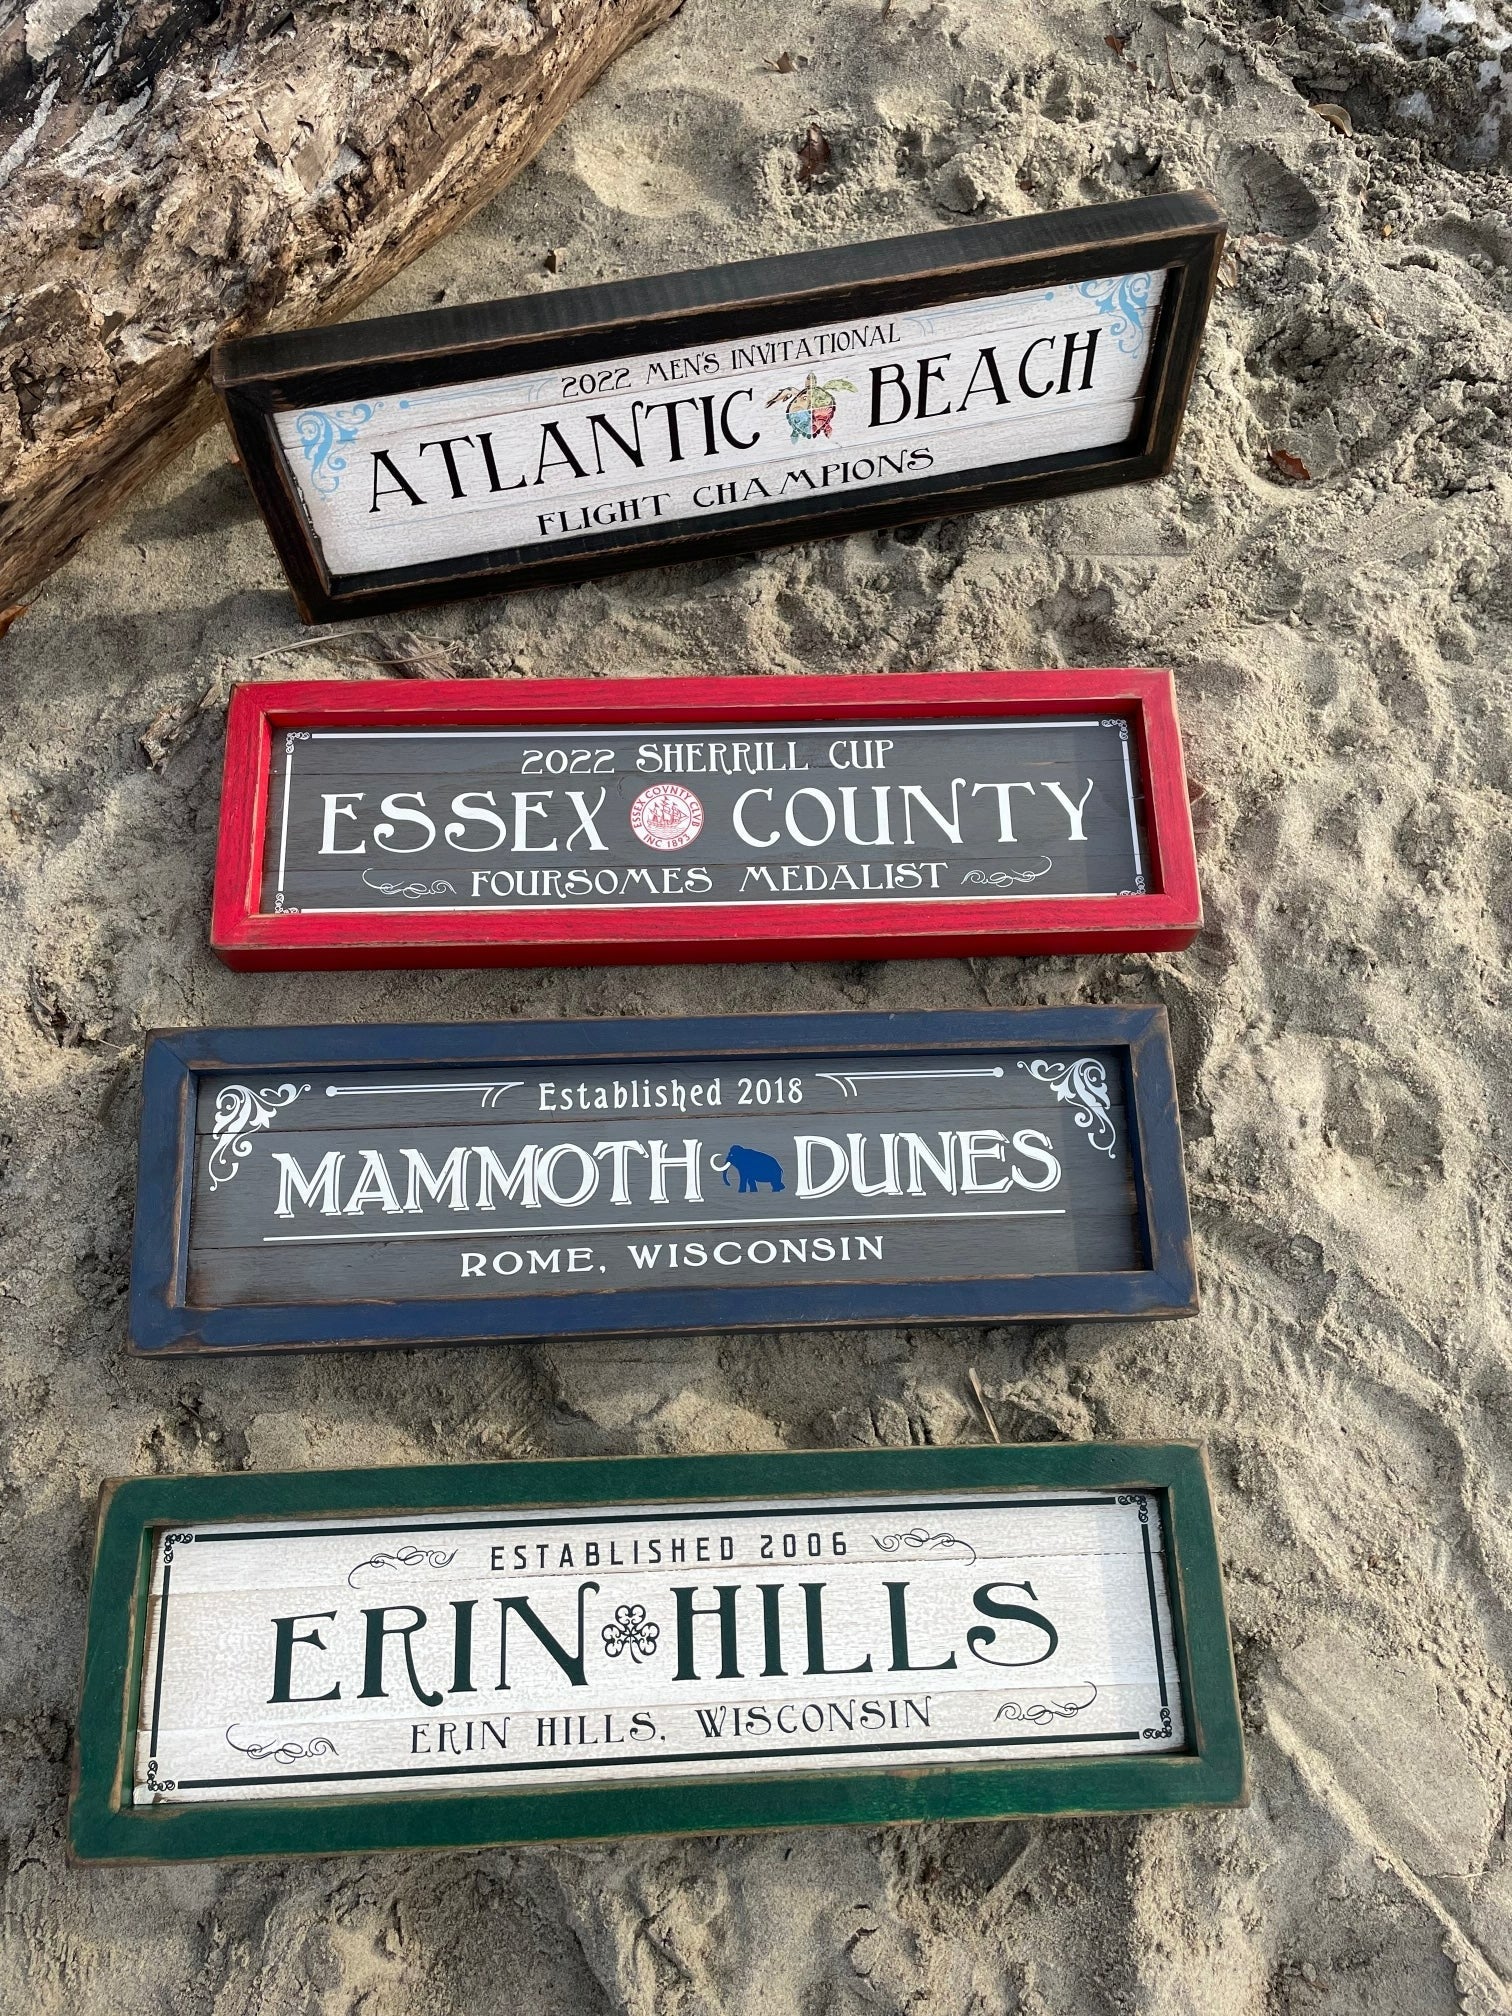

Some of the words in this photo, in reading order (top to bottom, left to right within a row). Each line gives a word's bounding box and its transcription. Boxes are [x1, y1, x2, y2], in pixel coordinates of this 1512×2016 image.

[562, 368, 631, 397] 2022
[646, 351, 720, 384] MEN'S
[731, 323, 901, 370] INVITATIONAL
[368, 389, 760, 512] ATLANTIC
[868, 328, 1102, 427] BEACH
[537, 492, 670, 536] FLIGHT
[693, 447, 934, 506] CHAMPIONS
[522, 750, 614, 774] 2022
[636, 742, 808, 775] SHERRILL
[829, 740, 893, 769] CUP
[318, 787, 609, 854] ESSEX
[733, 778, 1093, 847] COUNTY
[632, 799, 646, 828] ESSEX
[643, 833, 663, 847] INC
[667, 833, 690, 848] 1893
[471, 867, 712, 898] FOURSOMES
[739, 863, 948, 891] MEDALIST
[539, 1078, 721, 1112] Established
[738, 1077, 802, 1104] 2018
[272, 1139, 704, 1218] MAMMOTH
[794, 1129, 1061, 1199] DUNES
[461, 1248, 605, 1277] ROME,
[627, 1236, 883, 1269] WISCONSIN
[491, 1537, 737, 1570] ESTABLISHED
[761, 1532, 846, 1558] 2006
[267, 1582, 600, 1707] ERIN
[670, 1581, 1058, 1681] HILLS
[411, 1717, 510, 1754] ERIN
[537, 1710, 665, 1746] HILLS,
[695, 1696, 931, 1737] WISCONSIN
